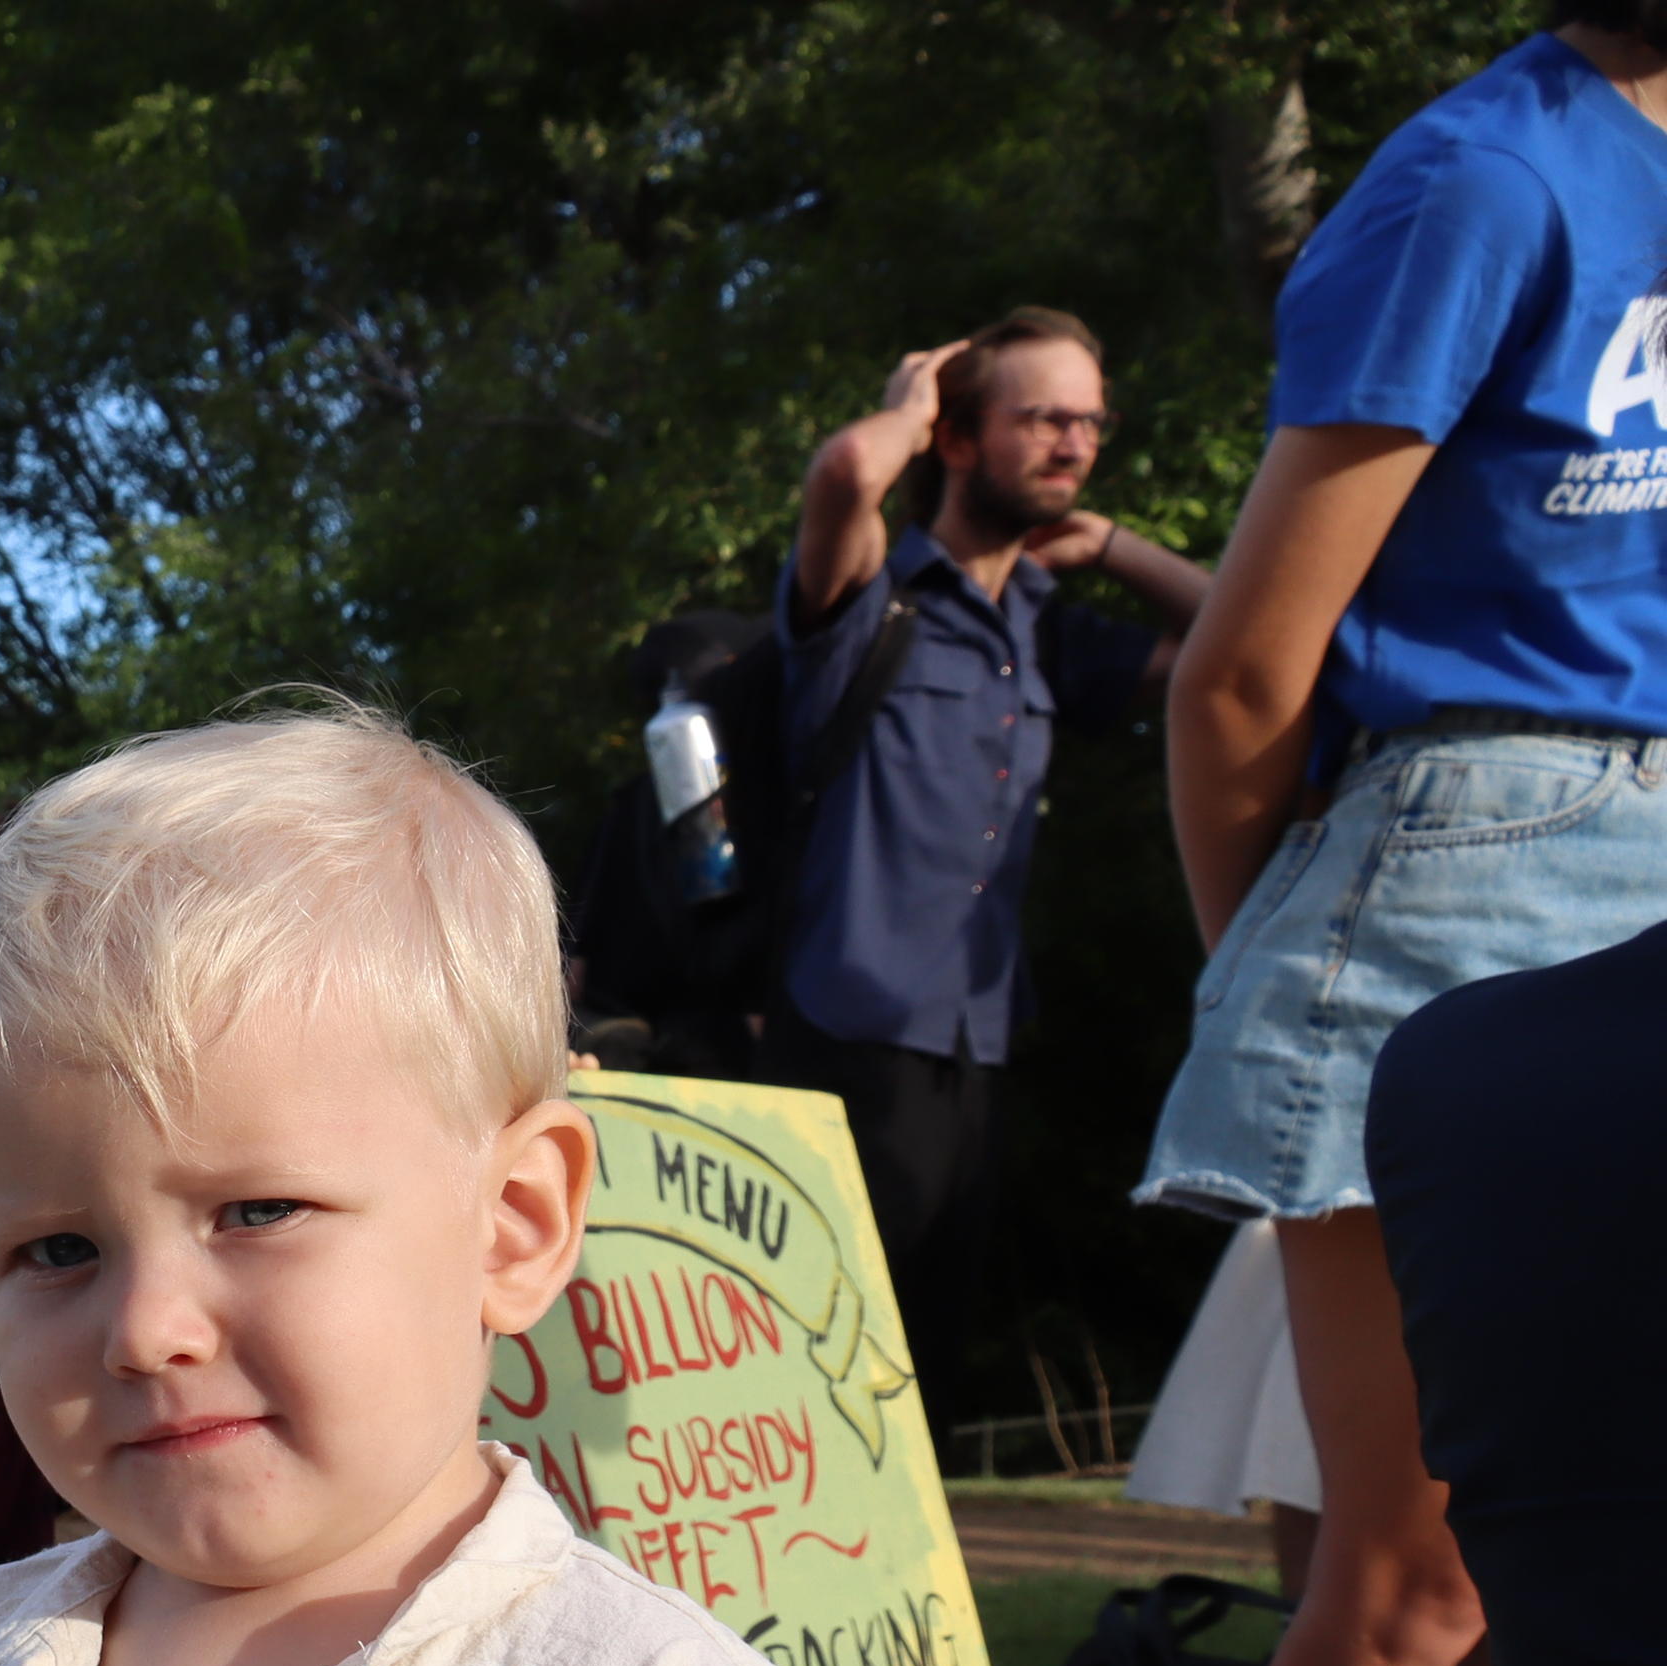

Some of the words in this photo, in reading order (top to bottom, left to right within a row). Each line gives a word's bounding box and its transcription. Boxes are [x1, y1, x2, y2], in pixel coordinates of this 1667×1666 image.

[651, 1129, 788, 1262] MENU
[565, 1265, 782, 1395] BILLION
[626, 1397, 816, 1516] SUBSIDY
